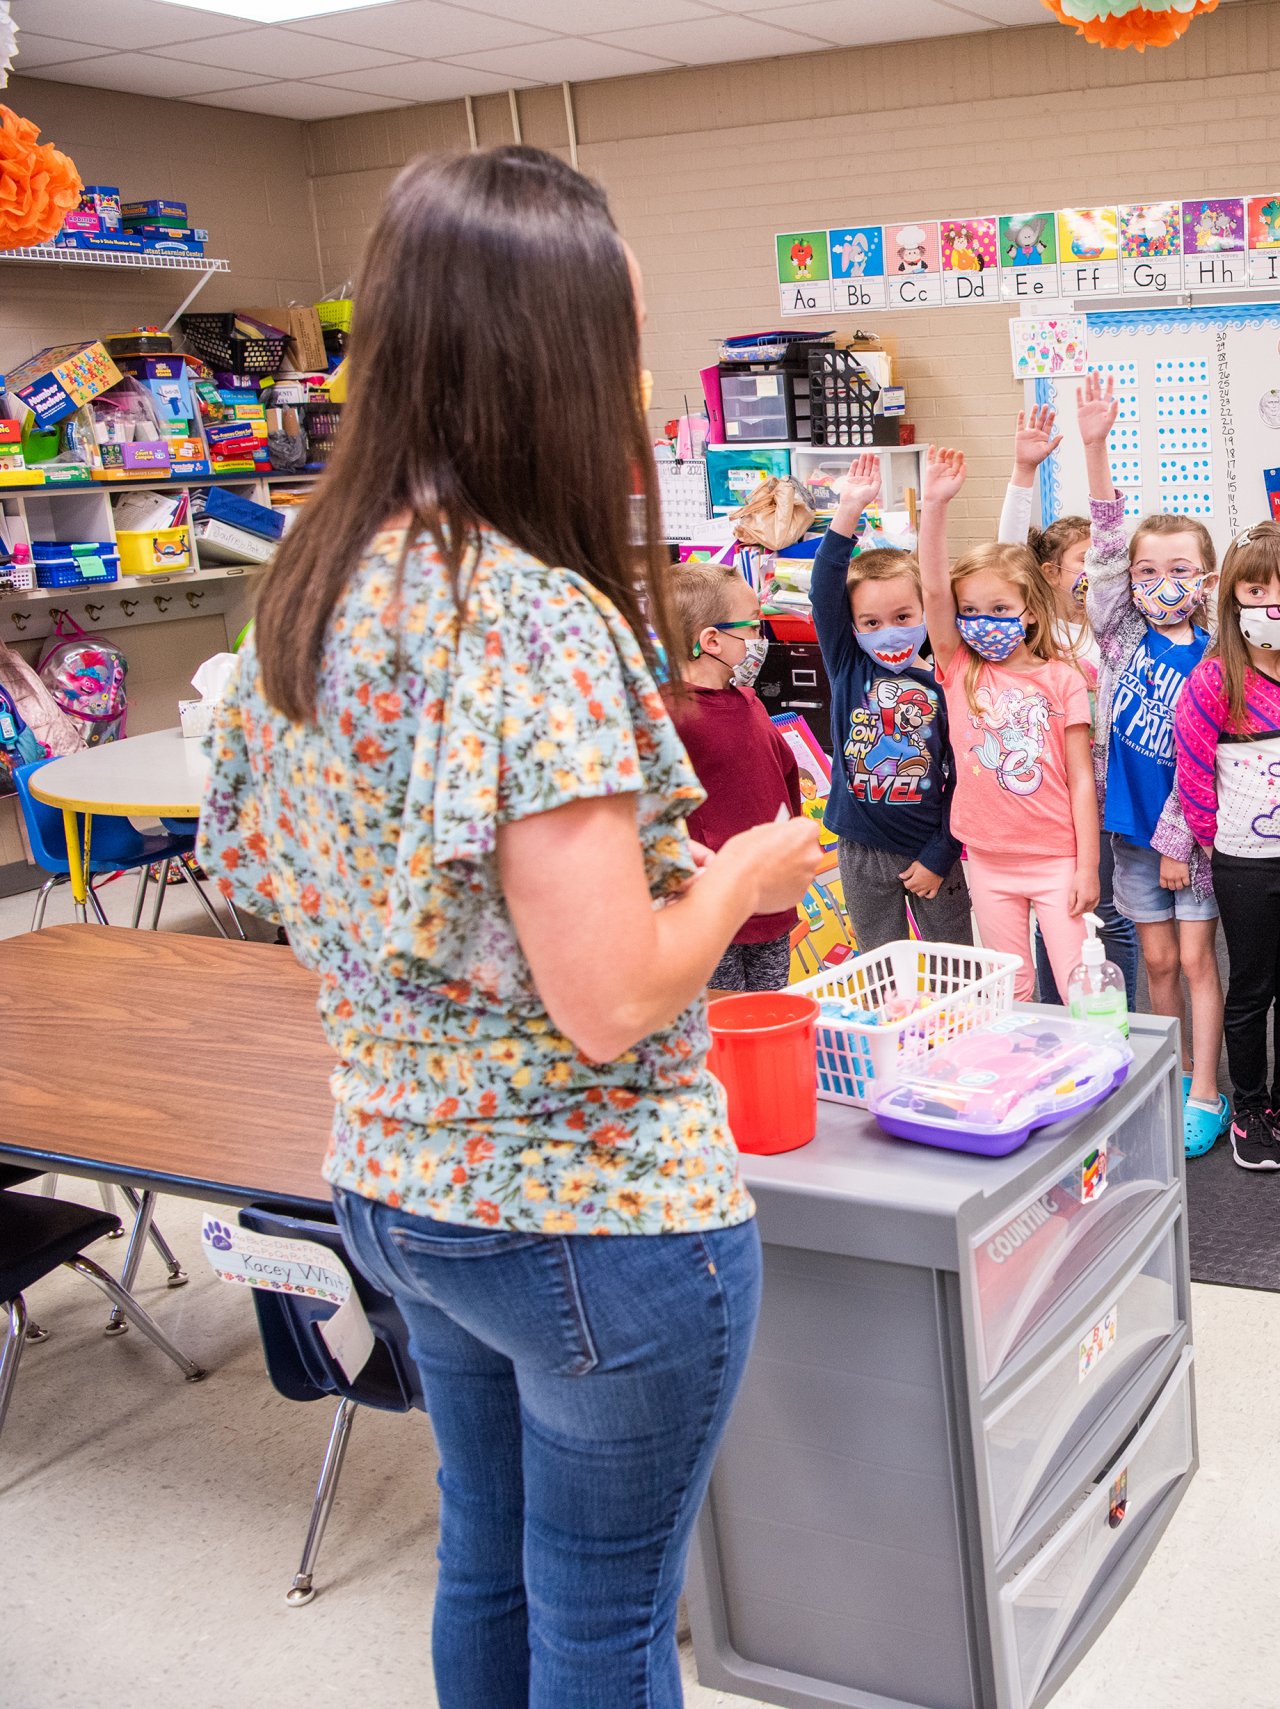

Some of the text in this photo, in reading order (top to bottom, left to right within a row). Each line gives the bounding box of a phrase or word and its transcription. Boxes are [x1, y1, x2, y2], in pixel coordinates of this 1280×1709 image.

[1016, 273, 1043, 295] Ee
[1077, 268, 1100, 291] Ff
[1133, 264, 1167, 291] Gg
[900, 281, 928, 302] Cc
[957, 276, 985, 298] Dd
[794, 289, 816, 309] Aa
[847, 285, 871, 306] Bb
[1216, 333, 1227, 341] 30
[1217, 342, 1225, 351] 29
[1217, 352, 1227, 361] 28
[1218, 362, 1229, 371] 27
[1219, 371, 1230, 380] 26
[1218, 381, 1230, 389] 25
[28, 384, 58, 406] Number
[1219, 389, 1229, 398] 24
[35, 391, 66, 414] Rockets
[1220, 408, 1233, 416] 22
[1222, 426, 1234, 435] 20
[1224, 437, 1234, 446] 19
[1226, 448, 1235, 458] 18
[1228, 460, 1236, 469] 17
[1227, 471, 1236, 480] 16
[1228, 483, 1237, 492] 15
[851, 707, 880, 726] GET
[852, 725, 877, 743] ON
[844, 742, 872, 759] MY
[986, 1195, 1059, 1264] COUNTING
[242, 1254, 290, 1282] Kacey
